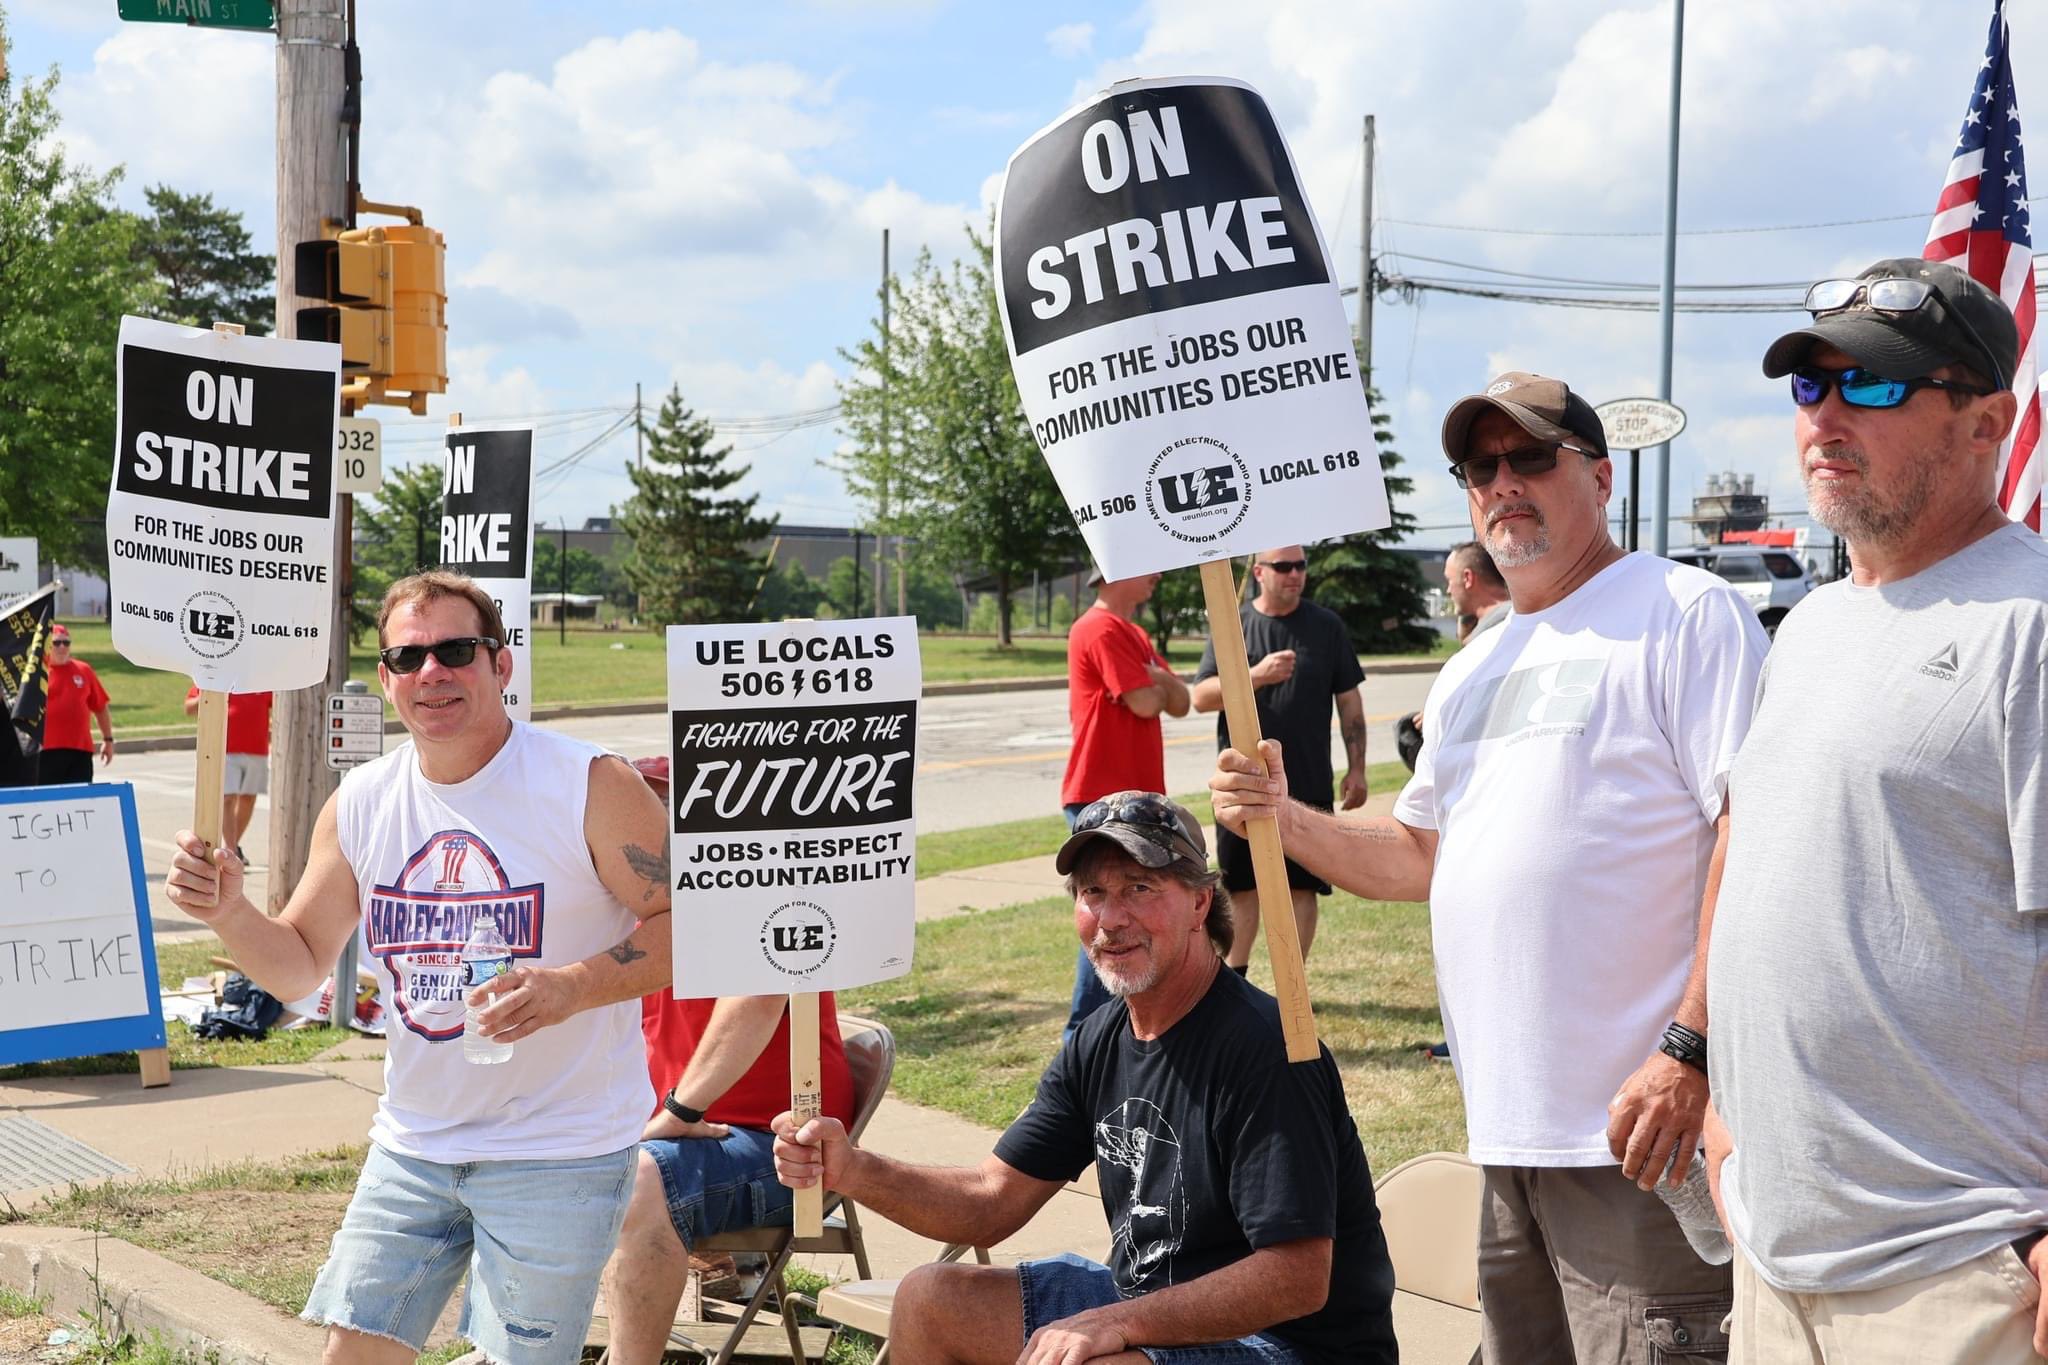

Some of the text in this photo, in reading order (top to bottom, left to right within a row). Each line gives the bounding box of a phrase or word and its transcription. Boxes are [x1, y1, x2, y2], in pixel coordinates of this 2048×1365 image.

[157, 0, 239, 19] MAIN ST
[1081, 105, 1190, 194] ON
[1026, 196, 1296, 321] STRIKE
[1048, 316, 1308, 400] FOR THE JOBS OUR
[186, 370, 254, 426] ON
[1035, 352, 1352, 450] COMMUNITIES DESERVE
[1616, 417, 1648, 431] STOP
[134, 431, 310, 500] STRIKE
[344, 459, 365, 479] 10
[1259, 450, 1360, 485] LOCAL 618
[1101, 494, 1137, 517] 506
[1145, 436, 1252, 543] UNITED ELECTRICAL, RADIO AND MACHINE WORKERS OF AMERICA
[1158, 465, 1238, 514] UE
[1182, 507, 1228, 521] ueunion.org
[134, 515, 303, 553] FOR THE JOBS OUR
[114, 539, 327, 583] COMMUNITIES DESERVE
[121, 601, 174, 623] LOCAL 506
[190, 609, 234, 640] UE
[251, 623, 318, 638] LOCAL 618
[696, 634, 894, 665] UE LOCALS
[721, 667, 873, 697] 506 618
[1919, 665, 1959, 683] Reebok
[682, 714, 908, 749] FIGHTING FOR THE
[680, 751, 911, 819] FUTURE
[8, 809, 95, 840] IGHT
[689, 832, 902, 863] JOBS RESPECT
[15, 868, 57, 893] TO
[676, 855, 911, 890] ACCOUNTABILITY
[761, 920, 770, 934] THE
[768, 903, 790, 920] UNION
[808, 902, 836, 930] EVERYONE
[773, 925, 823, 952] UE
[0, 934, 138, 985] TRIKE
[417, 954, 447, 964] SINCE
[762, 946, 786, 973] MEMBERS
[805, 963, 821, 974] THIS
[821, 942, 835, 964] UNION
